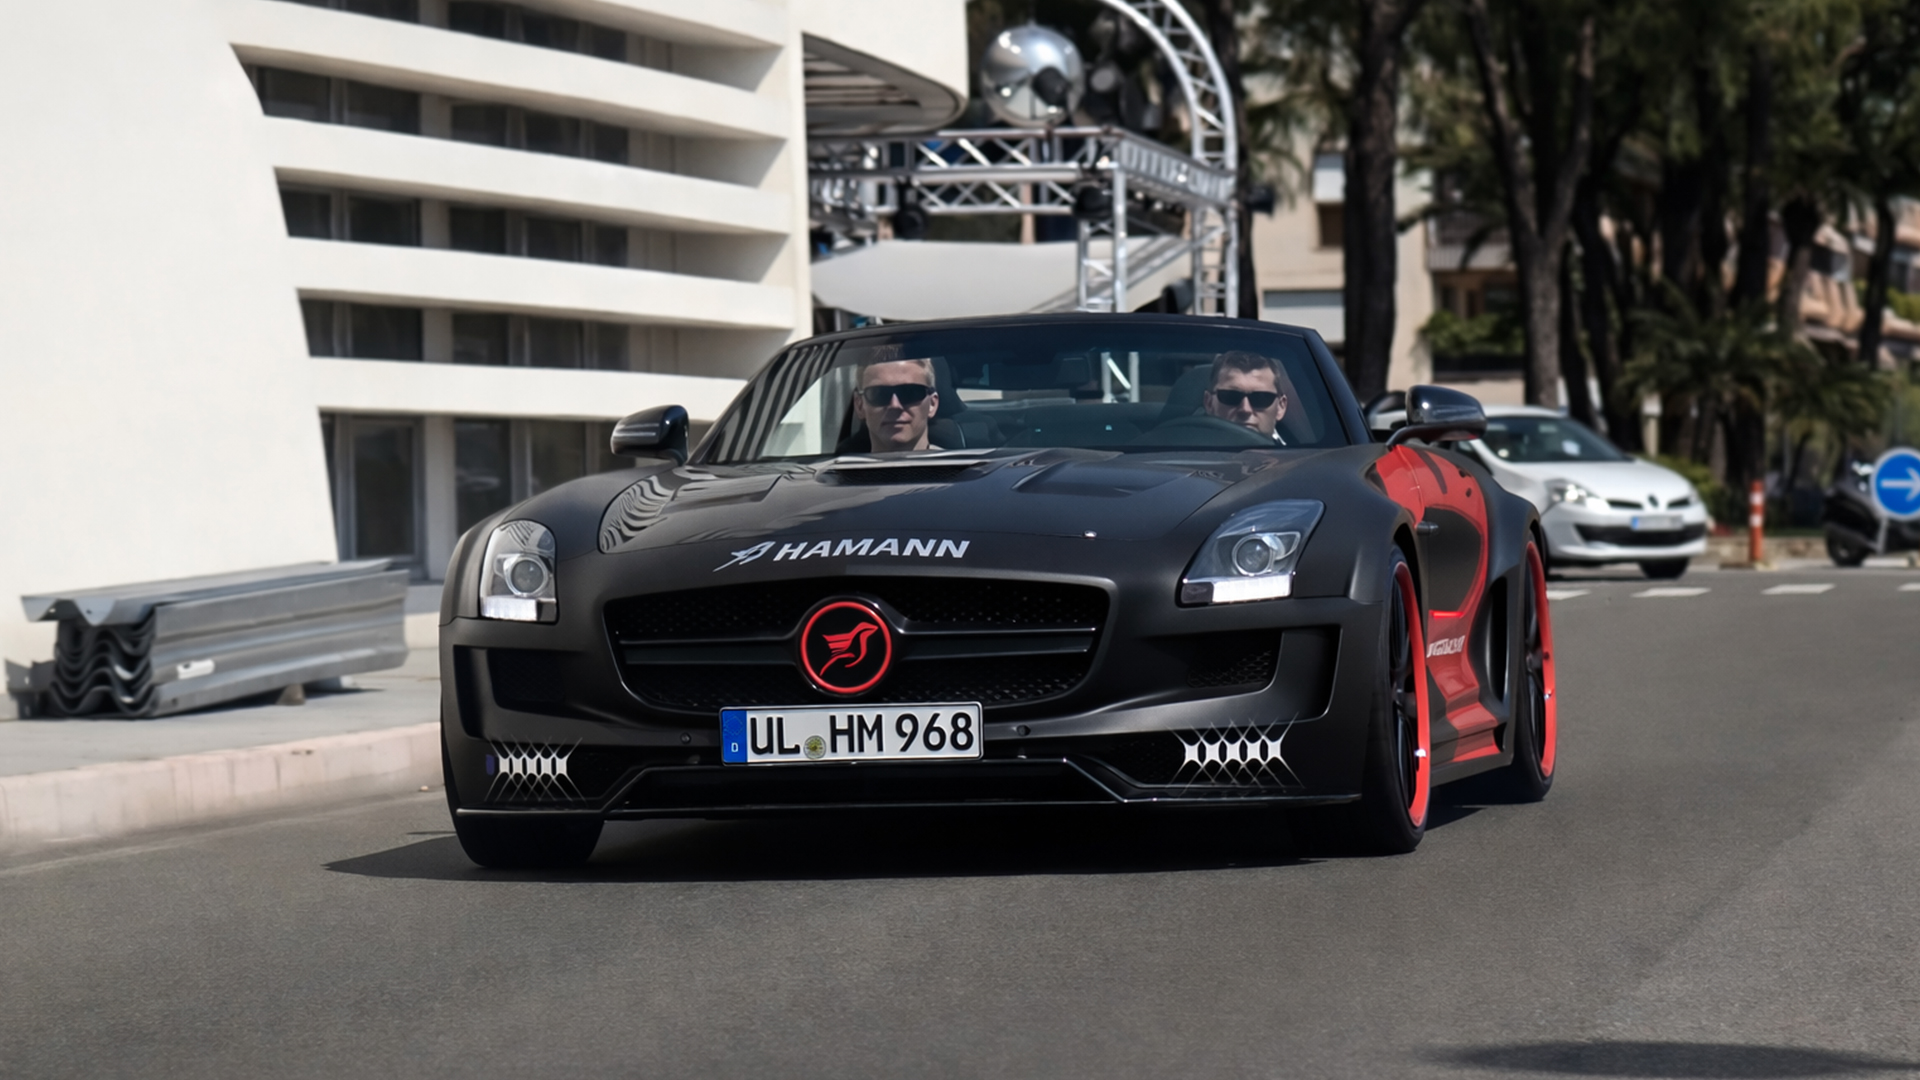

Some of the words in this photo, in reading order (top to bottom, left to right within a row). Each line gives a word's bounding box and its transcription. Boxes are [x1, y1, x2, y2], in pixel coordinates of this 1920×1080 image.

[773, 538, 970, 561] HAMANN
[750, 716, 800, 755] UL
[829, 714, 884, 753] HM
[895, 712, 974, 752] 968
[731, 742, 739, 752] D
